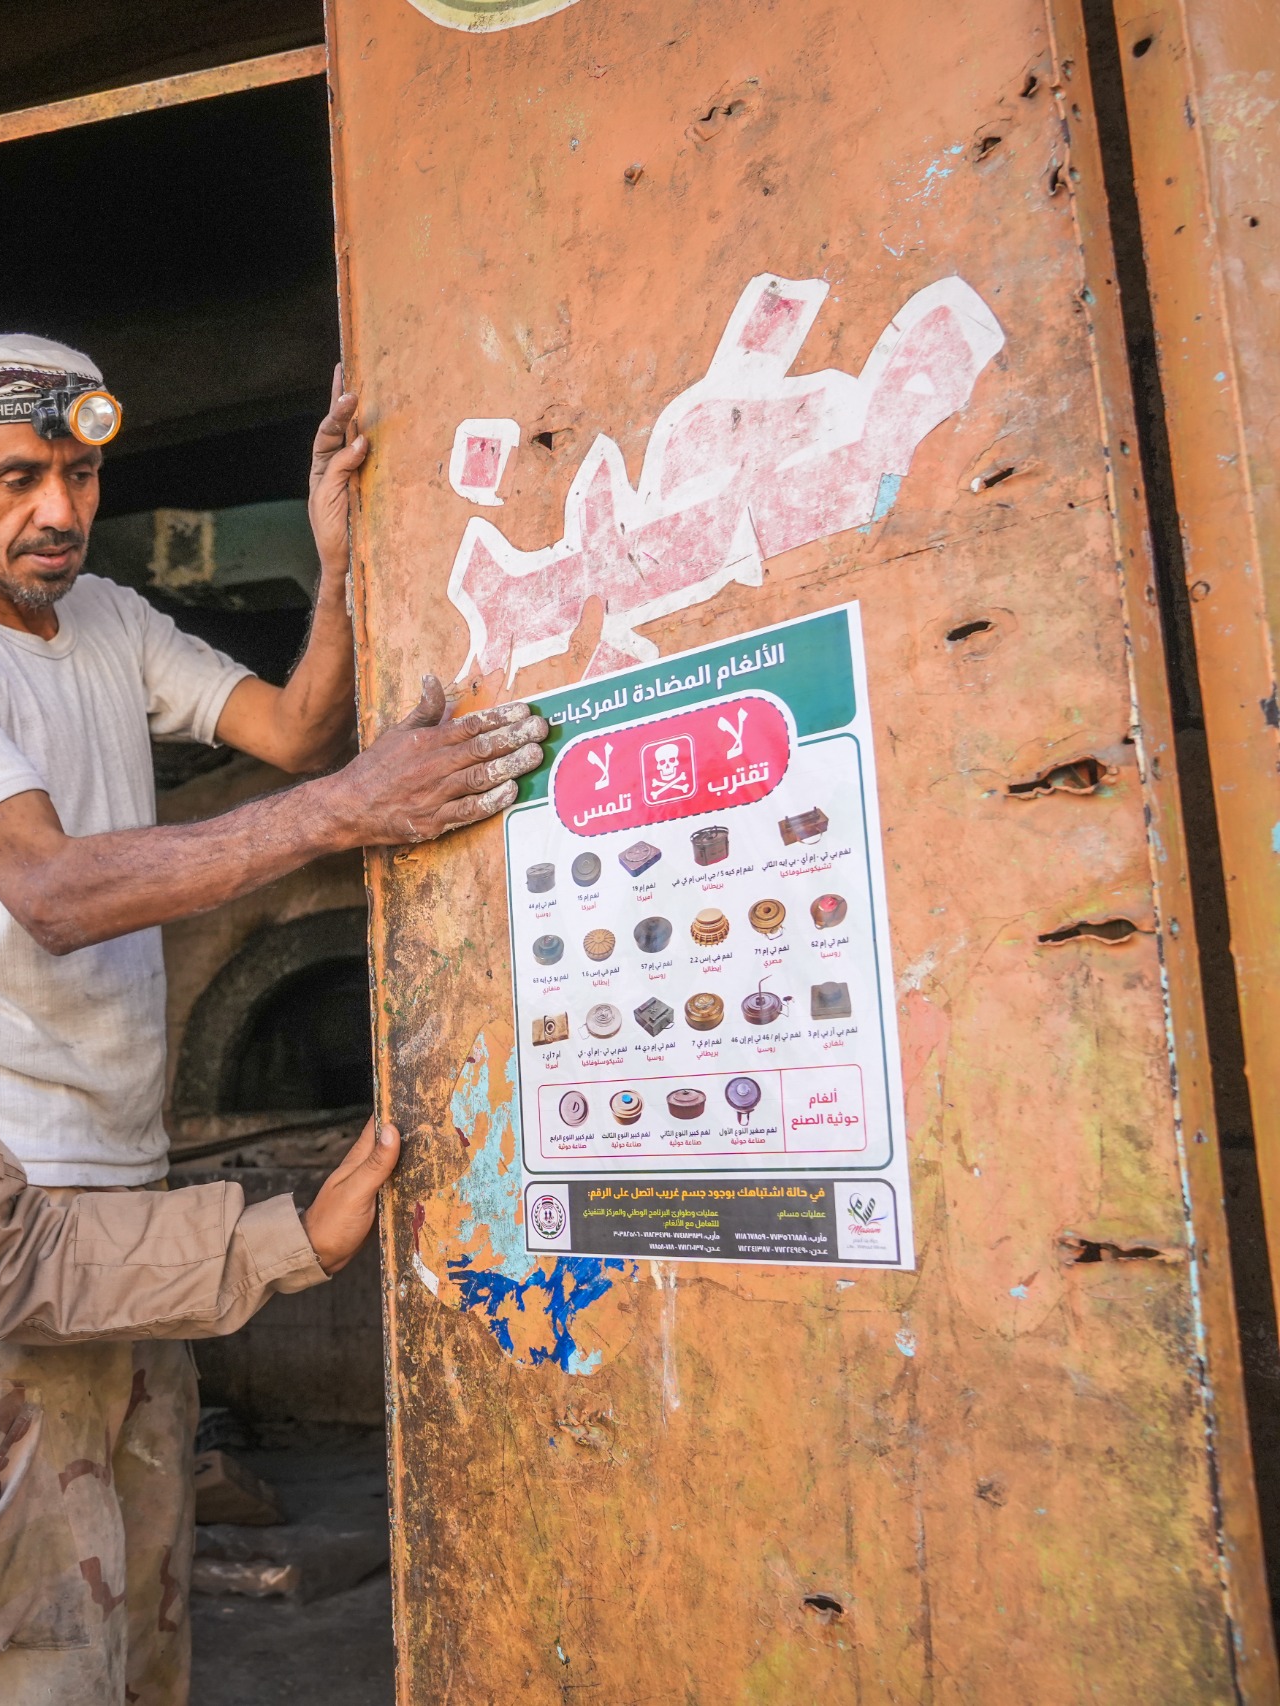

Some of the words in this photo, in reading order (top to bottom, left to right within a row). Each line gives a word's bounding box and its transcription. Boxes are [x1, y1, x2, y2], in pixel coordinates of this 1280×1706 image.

[716, 642, 784, 689] الألغام
[632, 664, 710, 702] المضادة
[548, 688, 628, 726] للمركبات
[717, 707, 748, 759] لا
[587, 742, 613, 790] لا
[707, 761, 769, 795] تقترب
[573, 792, 631, 826] تلمس
[809, 1088, 837, 1108] ألغام
[791, 1113, 823, 1130] الصنع
[826, 1111, 858, 1126] حوثية
[587, 1187, 611, 1200] الرقم:
[613, 1187, 629, 1199] على
[630, 1187, 653, 1199] اتصل
[655, 1187, 679, 1199] غريب
[681, 1190, 706, 1201] جسم
[707, 1190, 735, 1199] بوجود
[737, 1186, 784, 1199] اشتباهك
[786, 1186, 807, 1196] حالة
[809, 1187, 825, 1202] في
